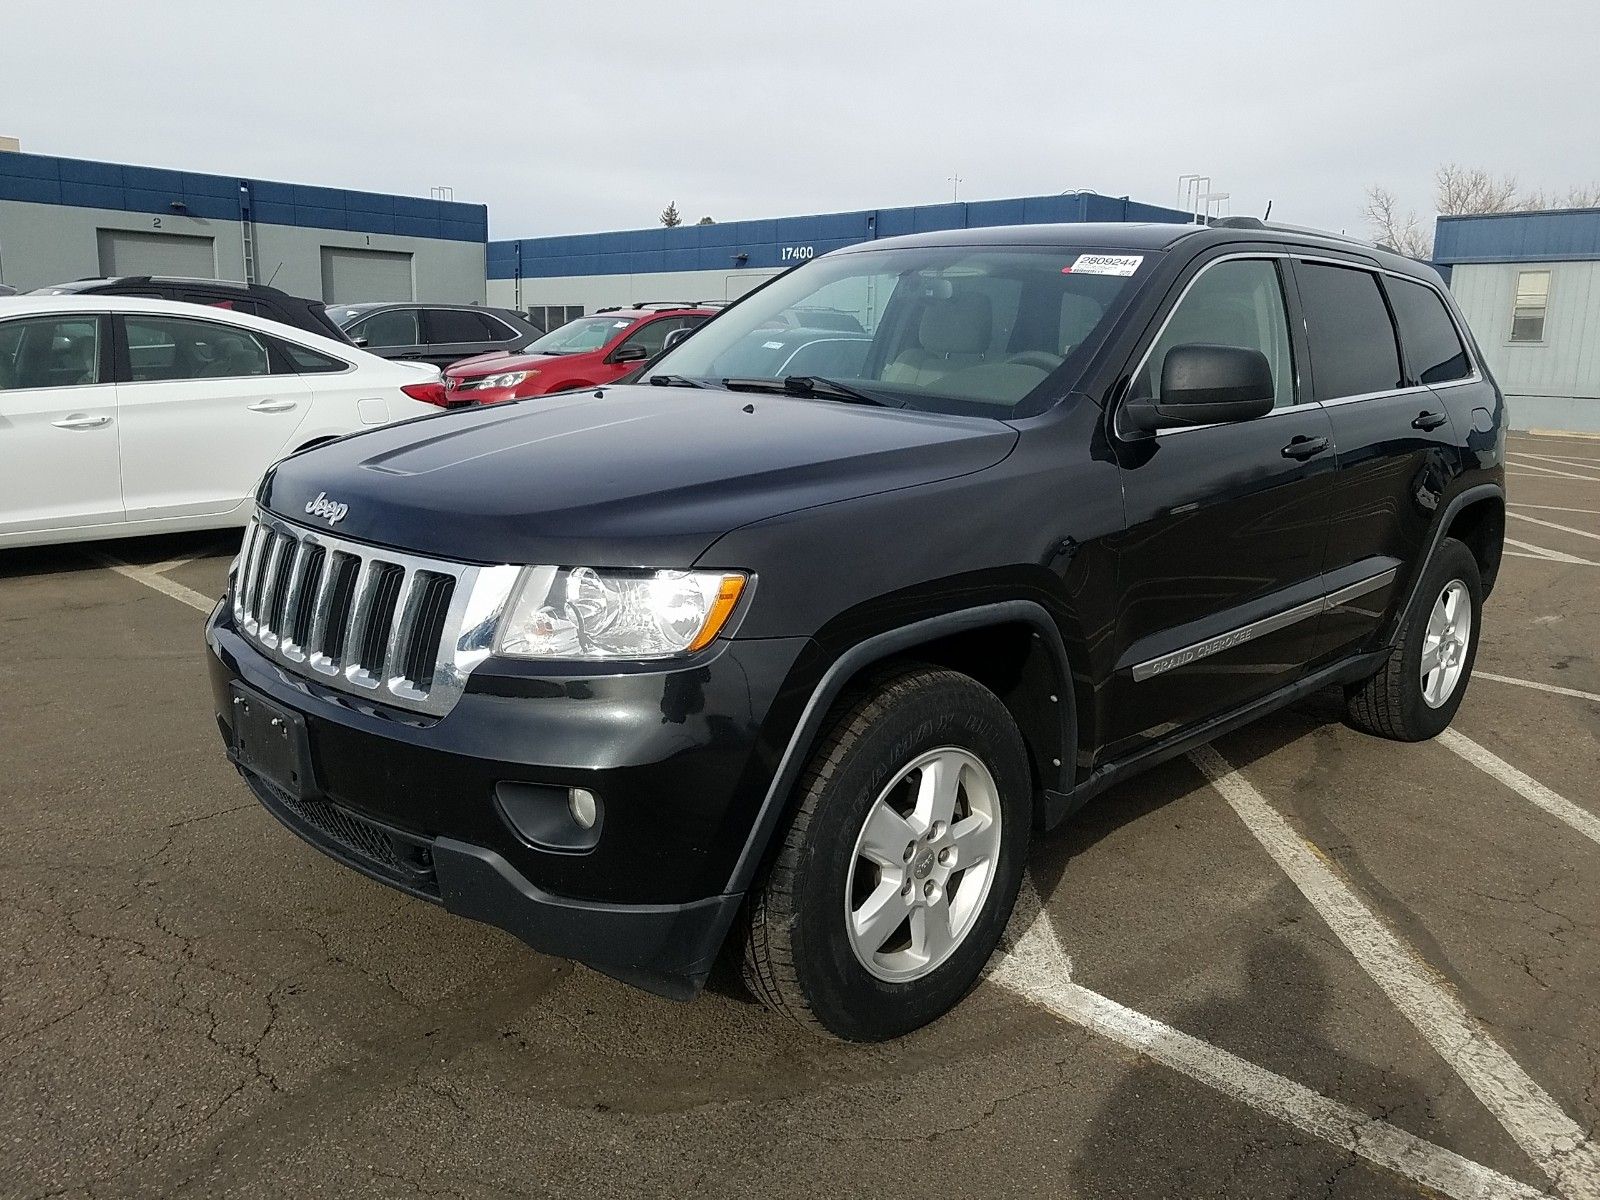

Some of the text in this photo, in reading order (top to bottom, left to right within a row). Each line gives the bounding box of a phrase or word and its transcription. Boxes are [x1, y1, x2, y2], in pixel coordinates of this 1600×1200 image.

[153, 217, 162, 229] 2
[781, 246, 814, 260] 17400
[1080, 256, 1137, 267] 2809244
[305, 491, 349, 527] Jeep
[1152, 628, 1253, 674] GRAND CHEROKEE
